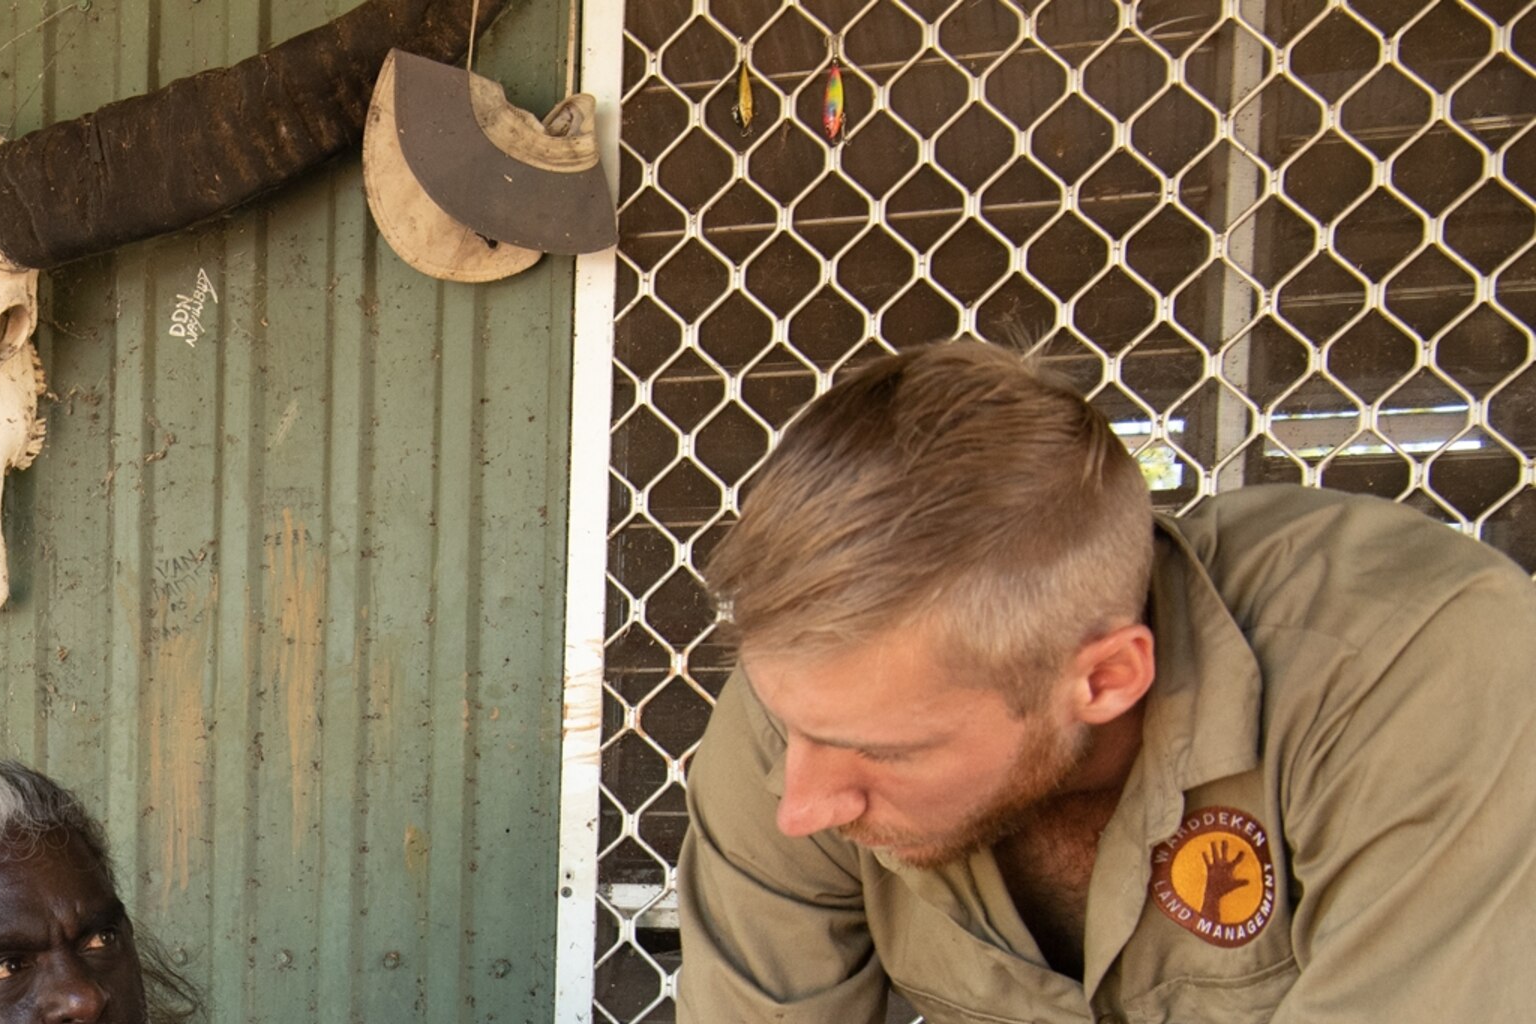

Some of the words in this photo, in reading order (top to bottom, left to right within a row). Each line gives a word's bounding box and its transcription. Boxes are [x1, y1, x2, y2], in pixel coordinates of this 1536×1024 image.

[1154, 811, 1267, 864] WARDDEKEN
[1153, 879, 1193, 921] LAND
[1196, 863, 1274, 941] MANAGEMENT
